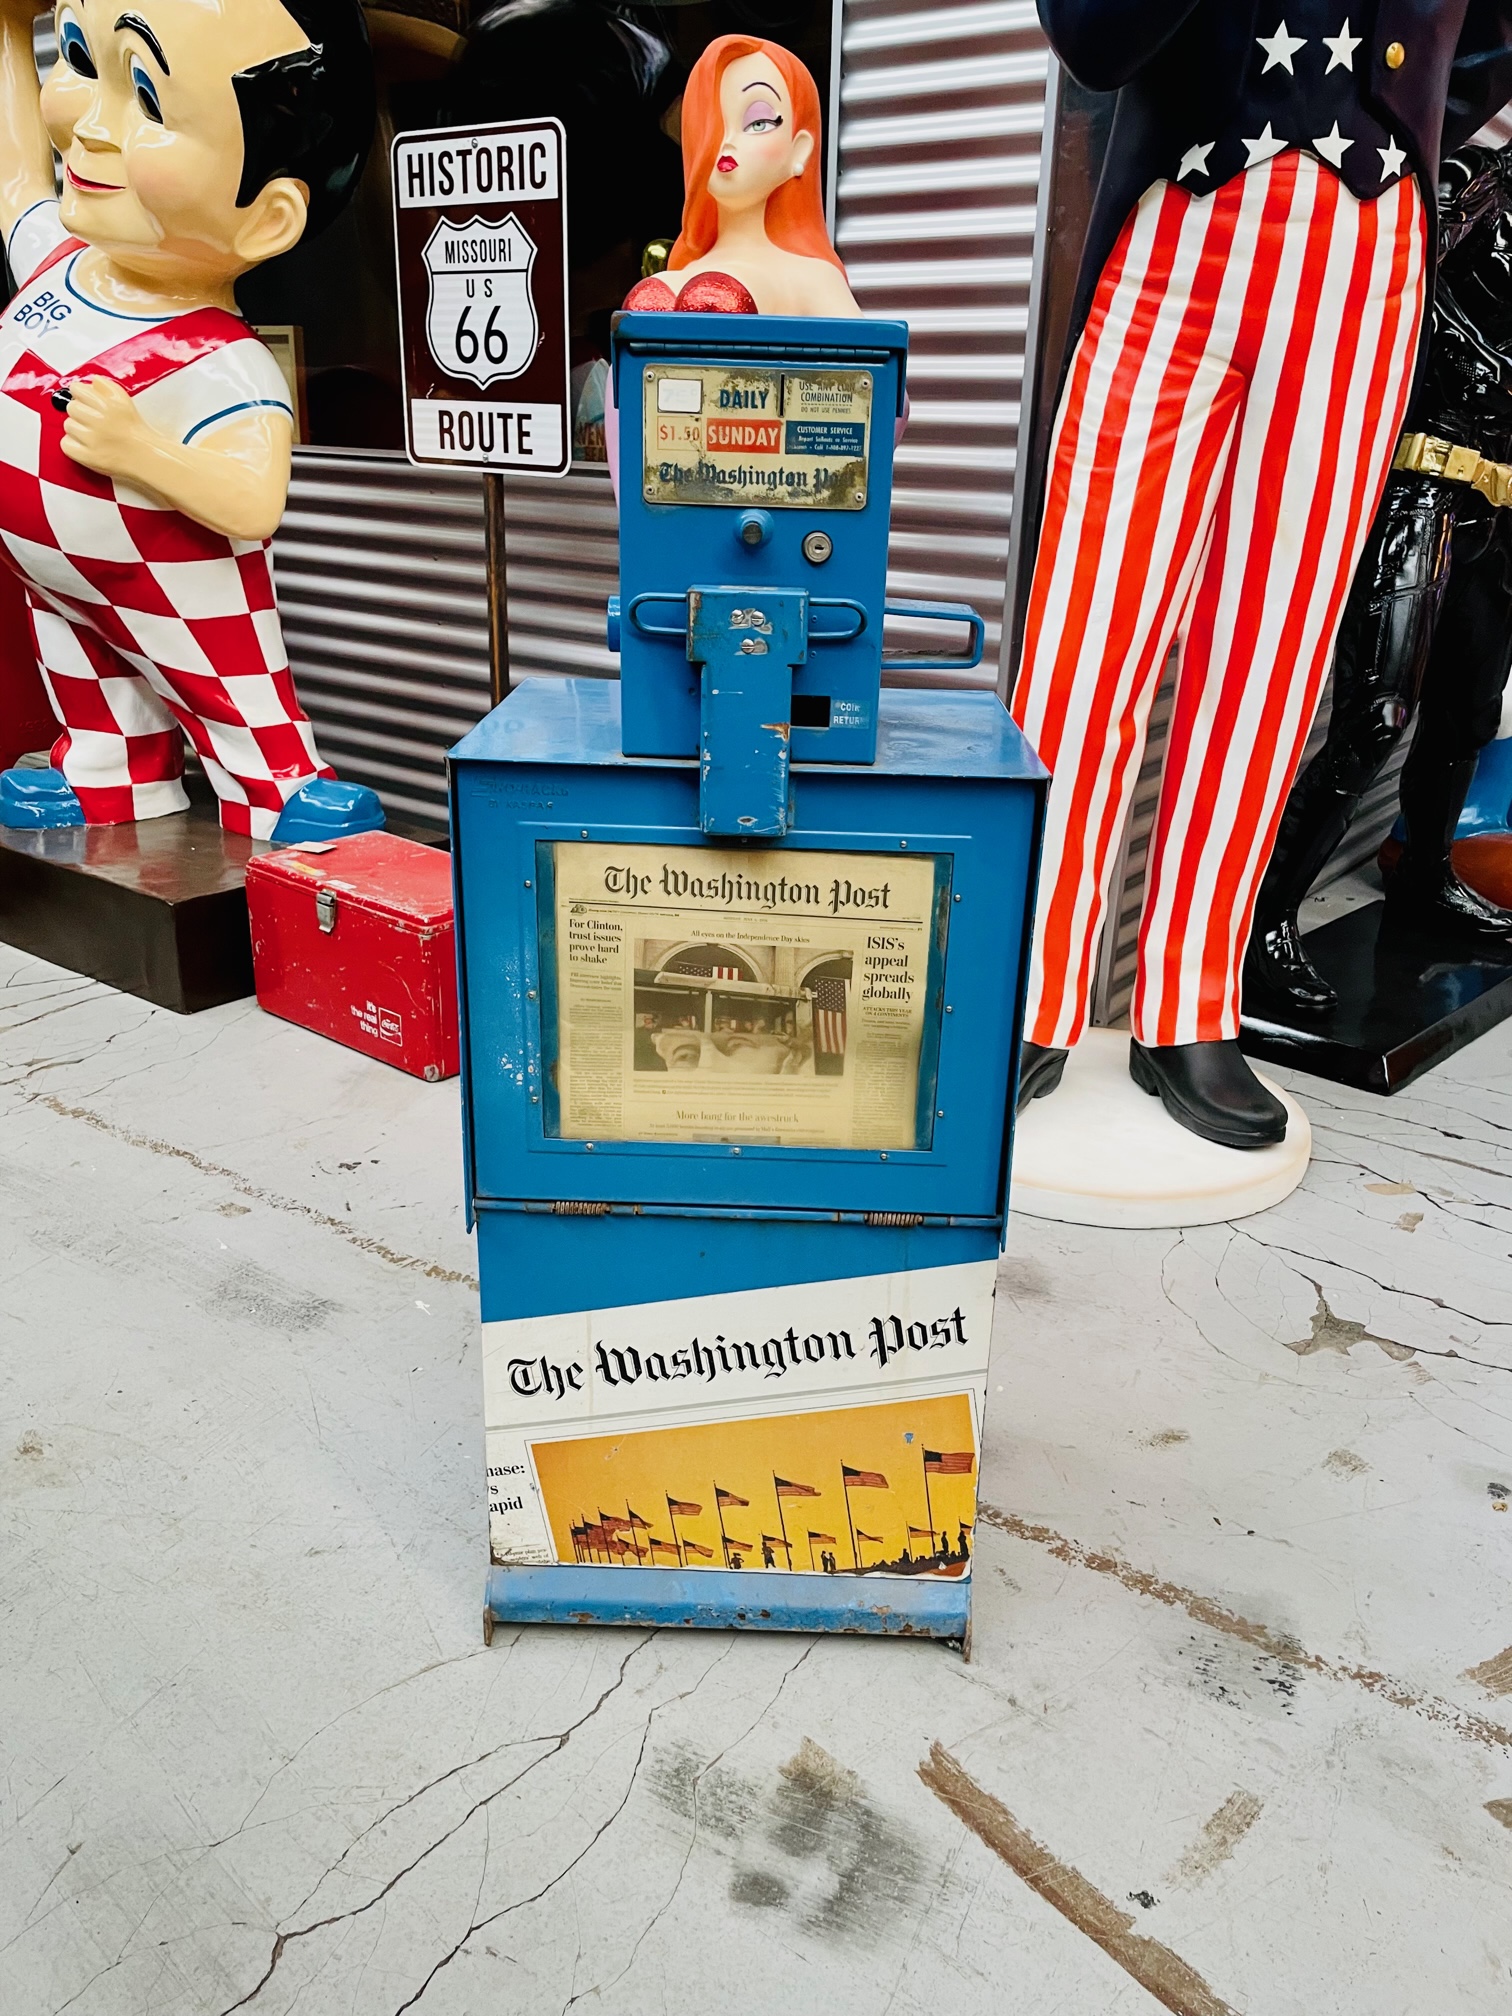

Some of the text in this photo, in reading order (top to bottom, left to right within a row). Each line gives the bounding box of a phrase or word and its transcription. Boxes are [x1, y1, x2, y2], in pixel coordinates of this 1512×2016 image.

[407, 142, 547, 198] HISTORIC
[445, 238, 512, 264] MISSOURI
[33, 291, 72, 321] BIG
[13, 304, 59, 338] BOY
[455, 305, 508, 364] 66
[720, 388, 769, 409] DAILY
[801, 391, 853, 403] COMBINATION
[438, 410, 533, 455] ROUTE
[660, 424, 700, 441] $1.50
[708, 425, 778, 446] SUNDAY
[797, 425, 853, 435] CUSTOMER SERVICE
[659, 462, 695, 484] The
[697, 459, 808, 491] Washington
[604, 863, 892, 915] The Washington Post
[569, 918, 585, 929] For
[569, 931, 621, 942] trust issues
[737, 932, 780, 942] Independence
[781, 935, 793, 944] Day
[569, 943, 619, 954] prove hard
[569, 953, 607, 964] to shake
[865, 955, 908, 969] appeal
[863, 971, 914, 985] spreads
[862, 986, 913, 1003] globally
[360, 1020, 378, 1038] thing
[677, 1110, 799, 1123] More bang for the awestruck
[507, 1306, 969, 1400] The Washington Post
